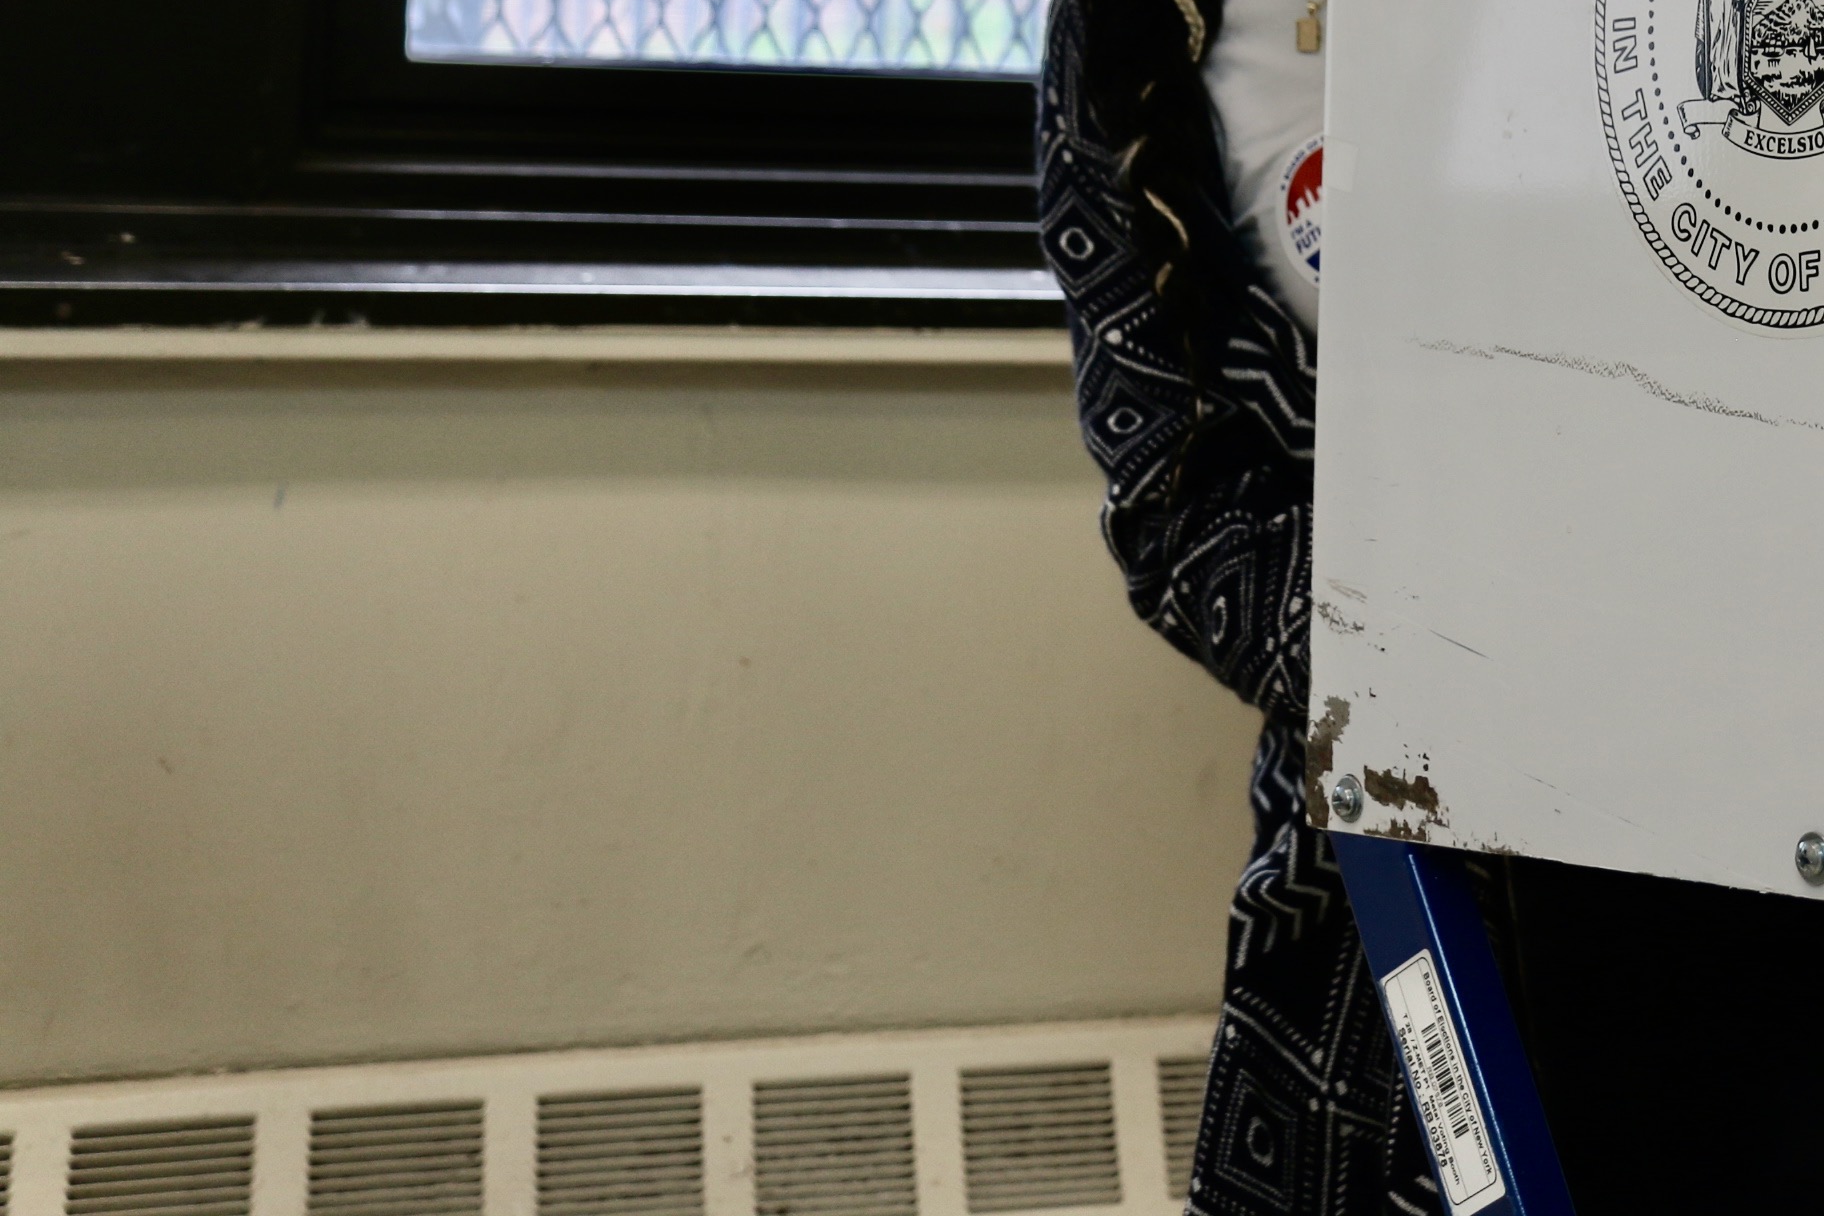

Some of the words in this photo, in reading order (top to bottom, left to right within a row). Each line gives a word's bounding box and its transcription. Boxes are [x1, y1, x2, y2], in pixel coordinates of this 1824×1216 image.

[1612, 16, 1637, 74] IN
[1620, 88, 1673, 199] THE
[1671, 203, 1760, 286] CITY
[1768, 251, 1822, 293] OF
[1423, 972, 1437, 1002] Board
[1434, 1004, 1442, 1014] of
[1398, 1026, 1415, 1067] Serial
[1411, 1069, 1423, 1090] No
[1421, 1100, 1434, 1124] RB
[1453, 1063, 1459, 1074] in
[1456, 1074, 1465, 1091] the
[1462, 1092, 1472, 1113] City
[1469, 1115, 1478, 1125] of
[1473, 1127, 1484, 1149] New
[1482, 1151, 1492, 1175] York
